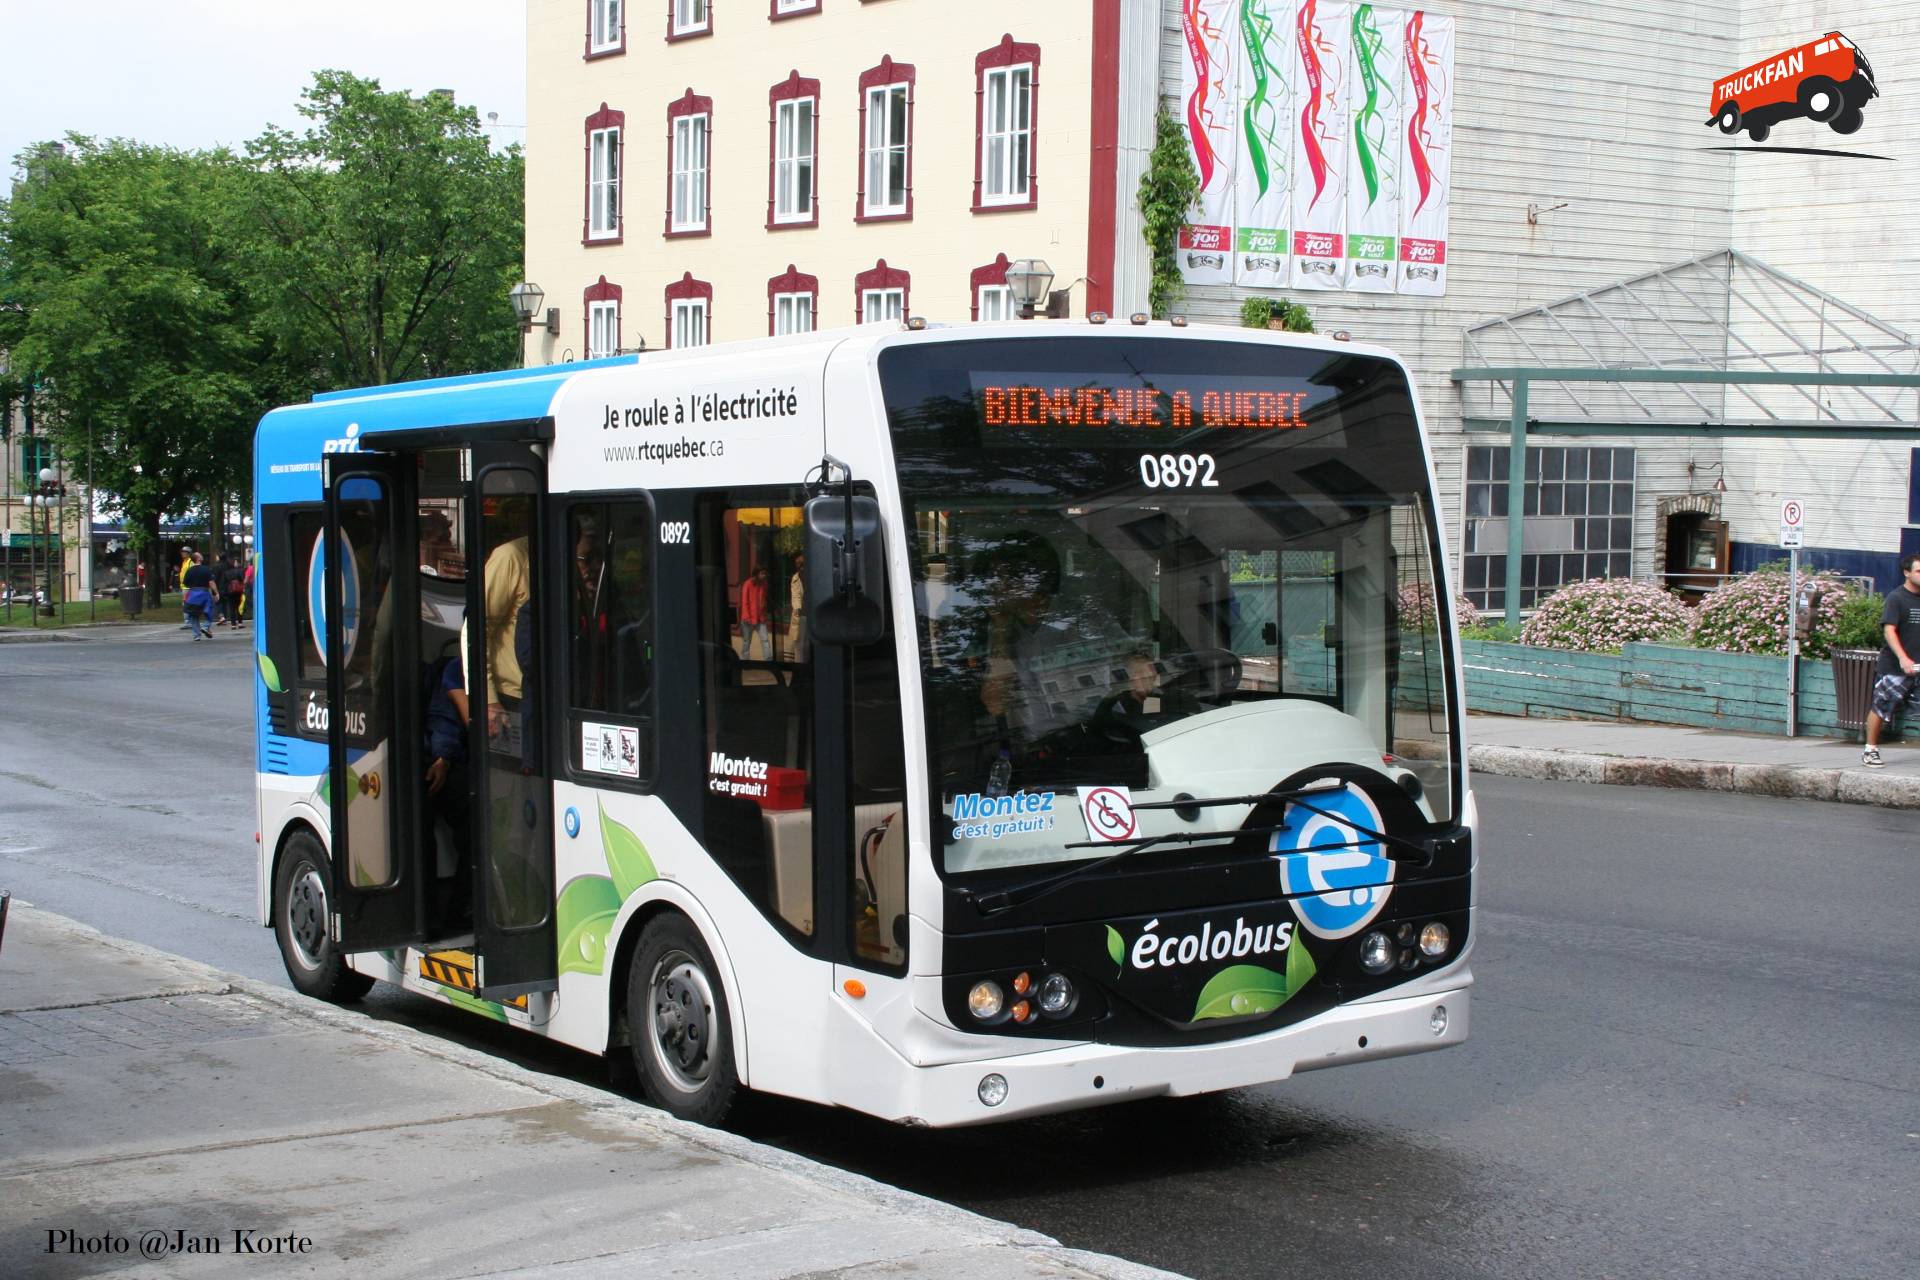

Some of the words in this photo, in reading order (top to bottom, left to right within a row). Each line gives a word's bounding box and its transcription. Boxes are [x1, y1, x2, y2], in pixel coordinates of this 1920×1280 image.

[1191, 233, 1219, 248] 400
[1249, 236, 1276, 250] 400
[1305, 240, 1332, 253] 400
[1359, 243, 1385, 257] 400
[1410, 246, 1435, 260] 400
[603, 405, 619, 430] Je
[625, 398, 669, 428] roule
[675, 397, 684, 424] à
[691, 386, 797, 423] l'électricité
[984, 387, 1161, 426] BIENVENUE
[1171, 390, 1192, 427] A
[1202, 391, 1307, 428] QUEBEC
[604, 436, 724, 465] www.rtcquebec.ca
[1139, 453, 1219, 488] 0892
[660, 521, 690, 544] 0892
[710, 751, 768, 780] Montez
[710, 777, 730, 792] c'est
[731, 782, 761, 796] gratuit
[953, 789, 1055, 821] Montez
[953, 823, 990, 839] c'est
[992, 816, 1045, 839] gratuit
[1131, 917, 1293, 969] écolobus
